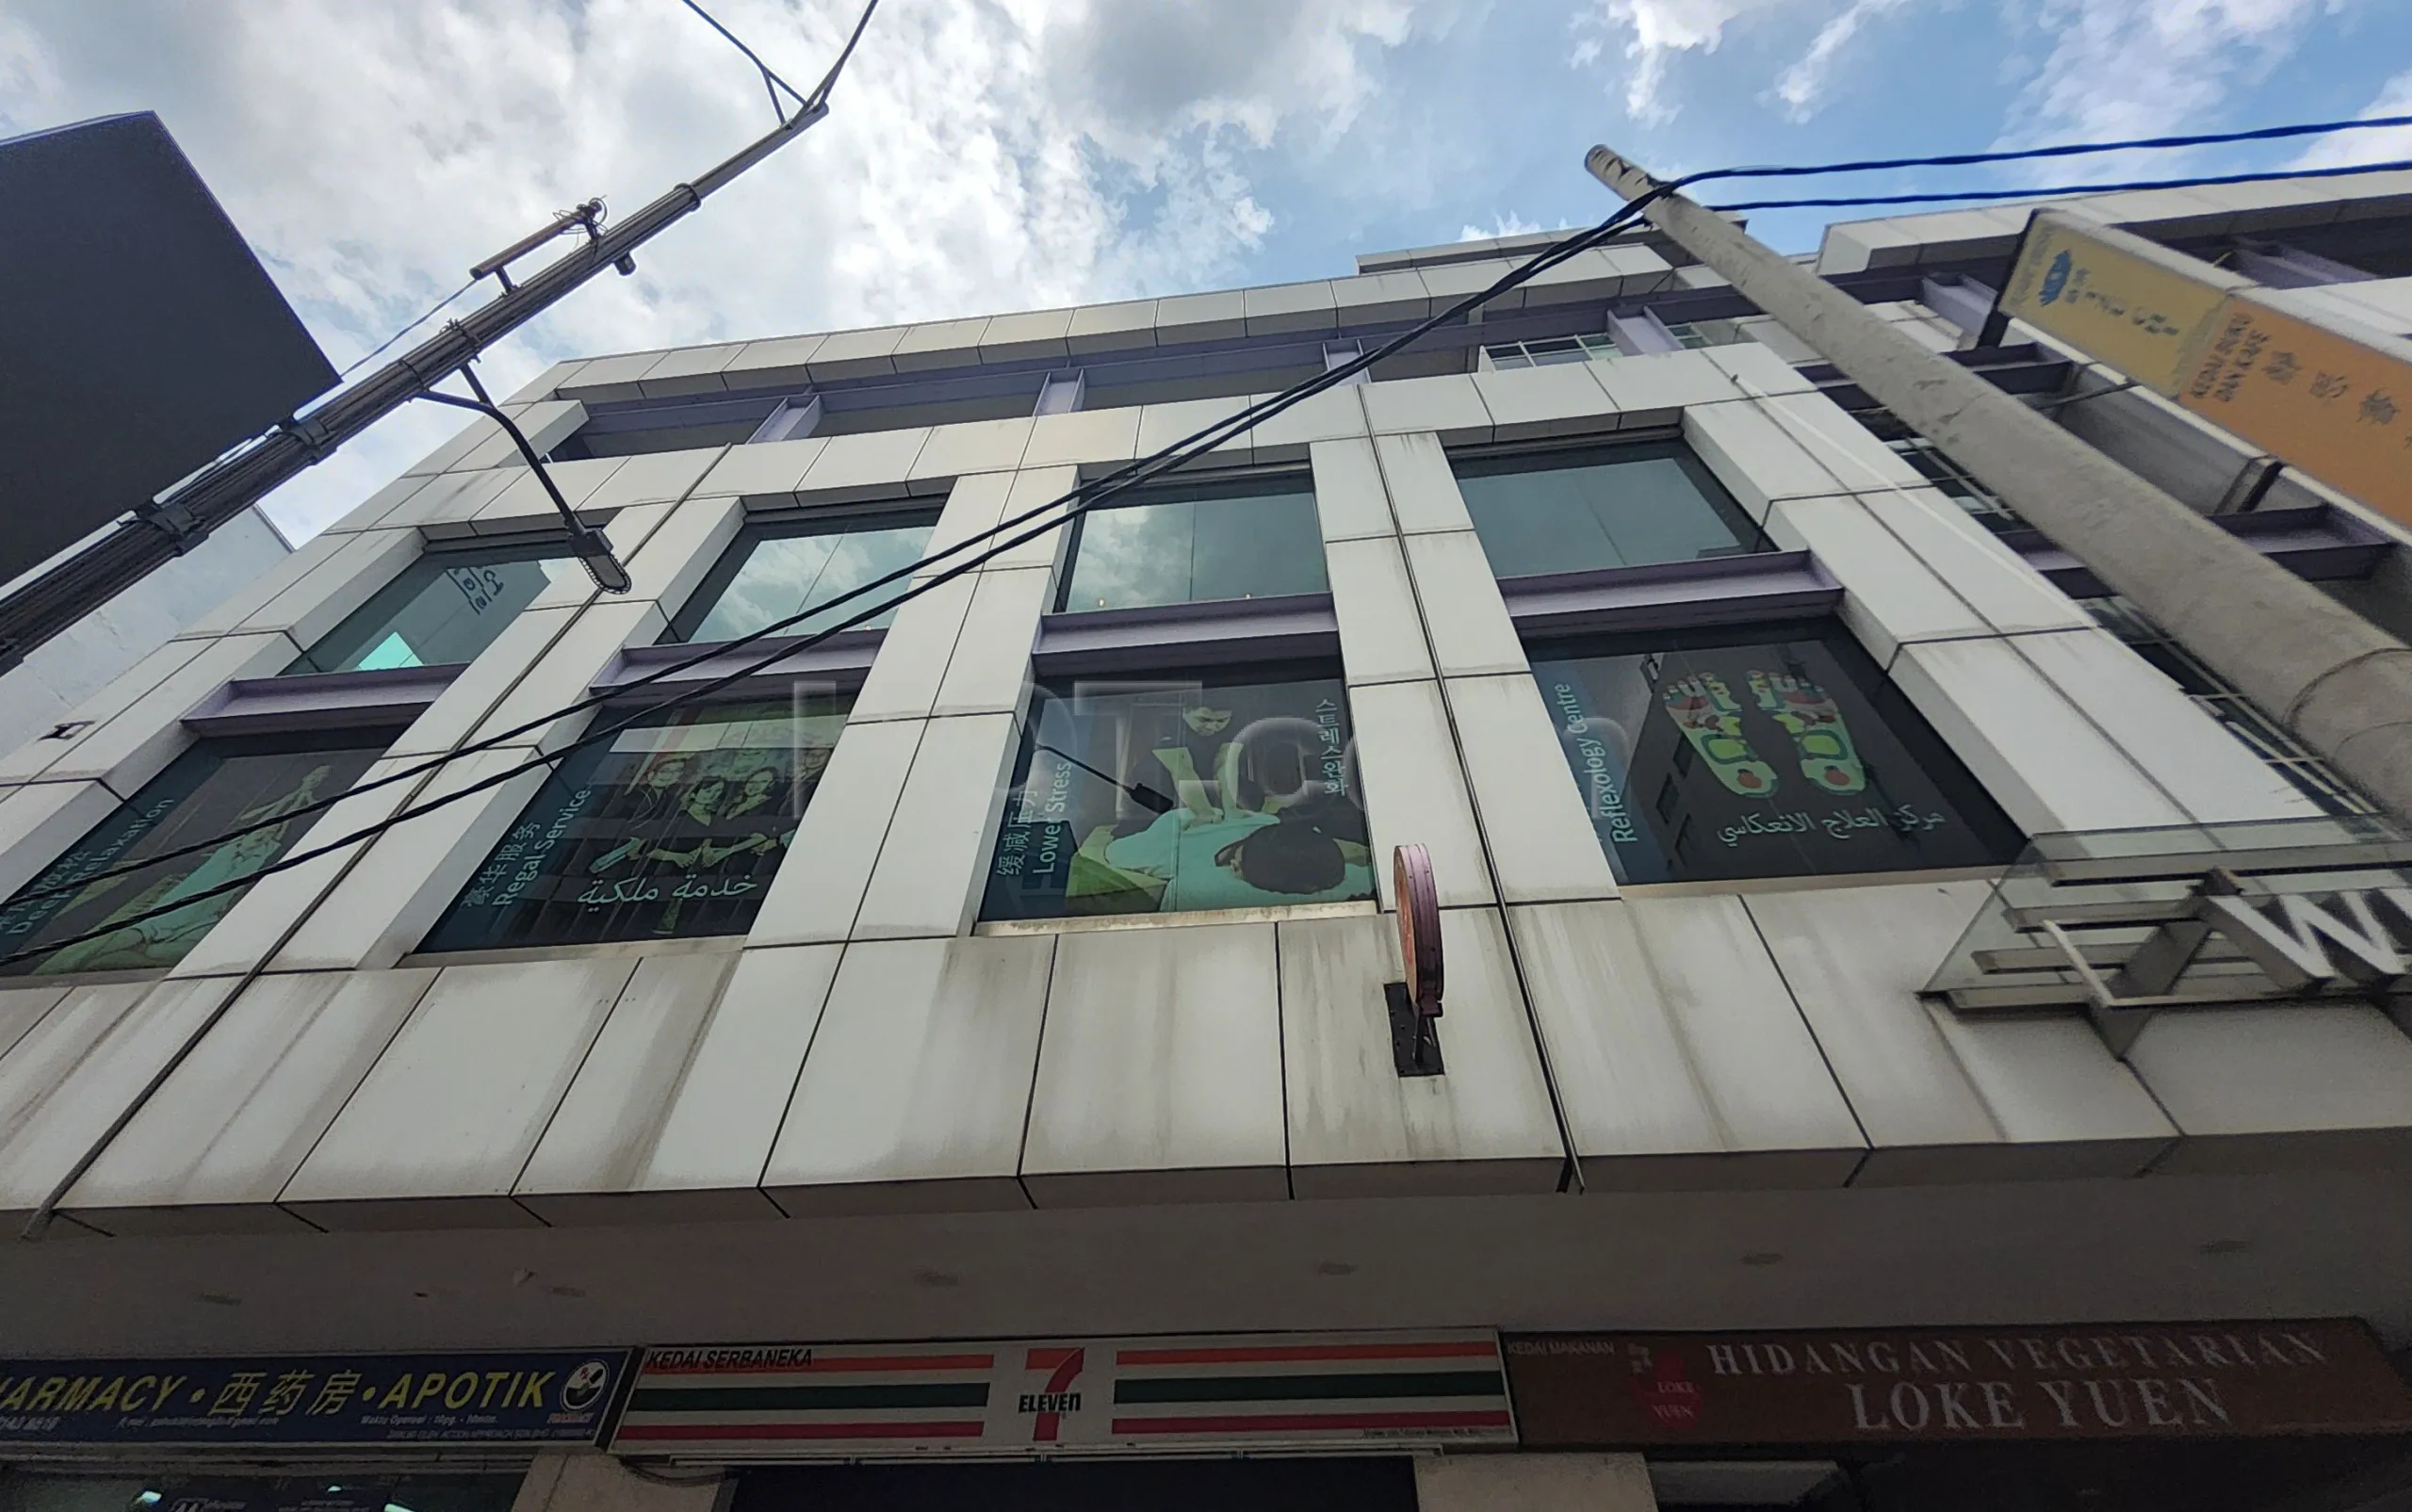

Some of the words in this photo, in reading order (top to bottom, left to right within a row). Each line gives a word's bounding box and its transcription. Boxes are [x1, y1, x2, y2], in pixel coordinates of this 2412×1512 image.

[1555, 683, 1589, 735] Centre
[1315, 698, 1348, 797] 스트레스완화
[1045, 761, 1072, 813] Stress
[1576, 738, 1638, 843] Reflexology
[66, 798, 174, 883] Relaxation
[996, 790, 1038, 876] 缓减压力
[1717, 811, 1817, 848] الانعكاسي
[1821, 806, 1889, 839] العلاج
[1894, 804, 1948, 831] مركز
[460, 821, 542, 908] 豪华服务
[491, 852, 546, 905] Regal
[533, 789, 591, 851] Service
[1033, 818, 1062, 874] Lower
[577, 876, 660, 913] ملكية
[672, 874, 758, 899] خدمة
[2208, 888, 2412, 978] W
[645, 1350, 700, 1370] KEDAI
[703, 1348, 812, 1369] SERBANEKA
[1508, 1341, 1547, 1355] KEDAI
[1548, 1341, 1616, 1355] MAKANAN
[1706, 1339, 1971, 1375] HIDANGAN
[1982, 1332, 2331, 1371] VEGETARIAN
[208, 1369, 363, 1417] 西药房
[377, 1371, 558, 1410] APOTIK
[1025, 1347, 1084, 1441] 7
[1656, 1380, 1699, 1394] LOKE
[1844, 1380, 2026, 1431] LOKE
[2036, 1377, 2234, 1429] YUEN
[1652, 1404, 1697, 1423] YUEN
